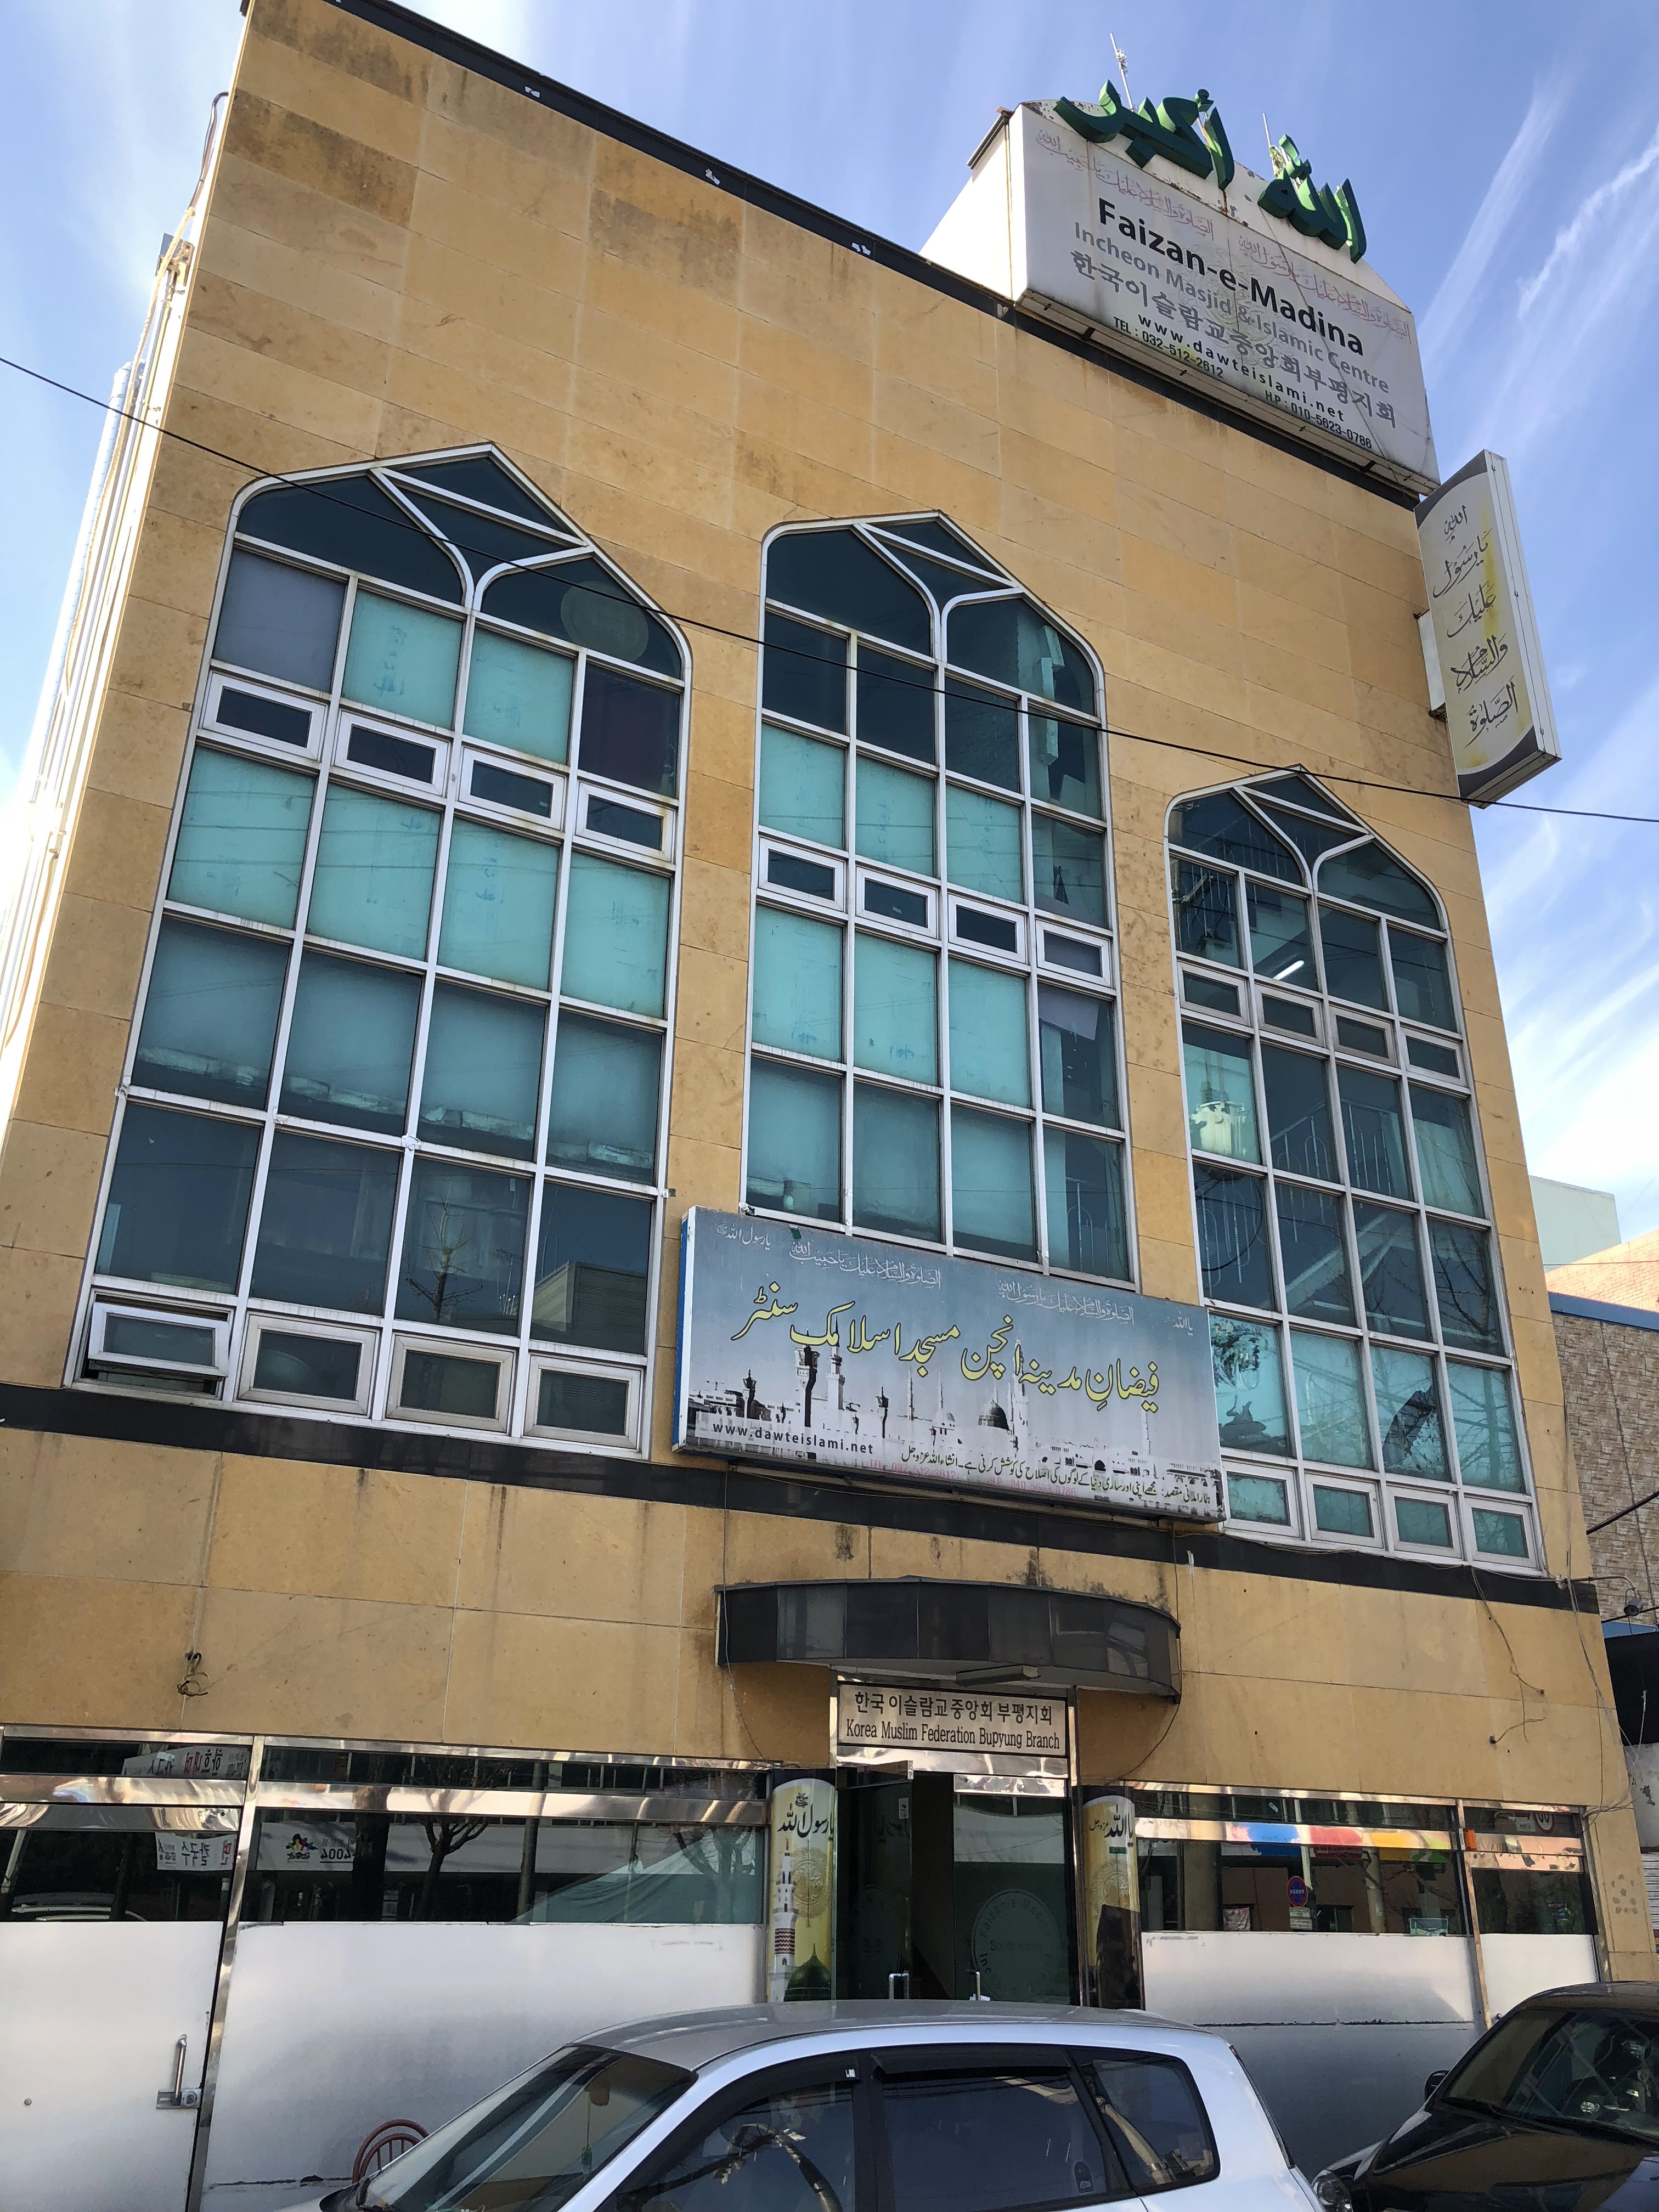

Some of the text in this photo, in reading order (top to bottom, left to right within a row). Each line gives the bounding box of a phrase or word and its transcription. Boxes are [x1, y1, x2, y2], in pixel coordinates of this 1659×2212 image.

[1099, 198, 1363, 356] Faizan-e-Madina
[1075, 221, 1389, 393] Incheon Masjid & Islamic Centre
[1138, 314, 1345, 422] www.dawteislami.net
[1142, 330, 1223, 378] 032-512-2612
[1291, 403, 1372, 449] 010-5623-0786
[713, 1423, 873, 1454] www.dawteislami.net
[855, 1691, 885, 1715] 한국
[997, 1703, 1052, 1726] 부평지회
[846, 1719, 1060, 1749] Korea Muslim Federation Bupyung Branch
